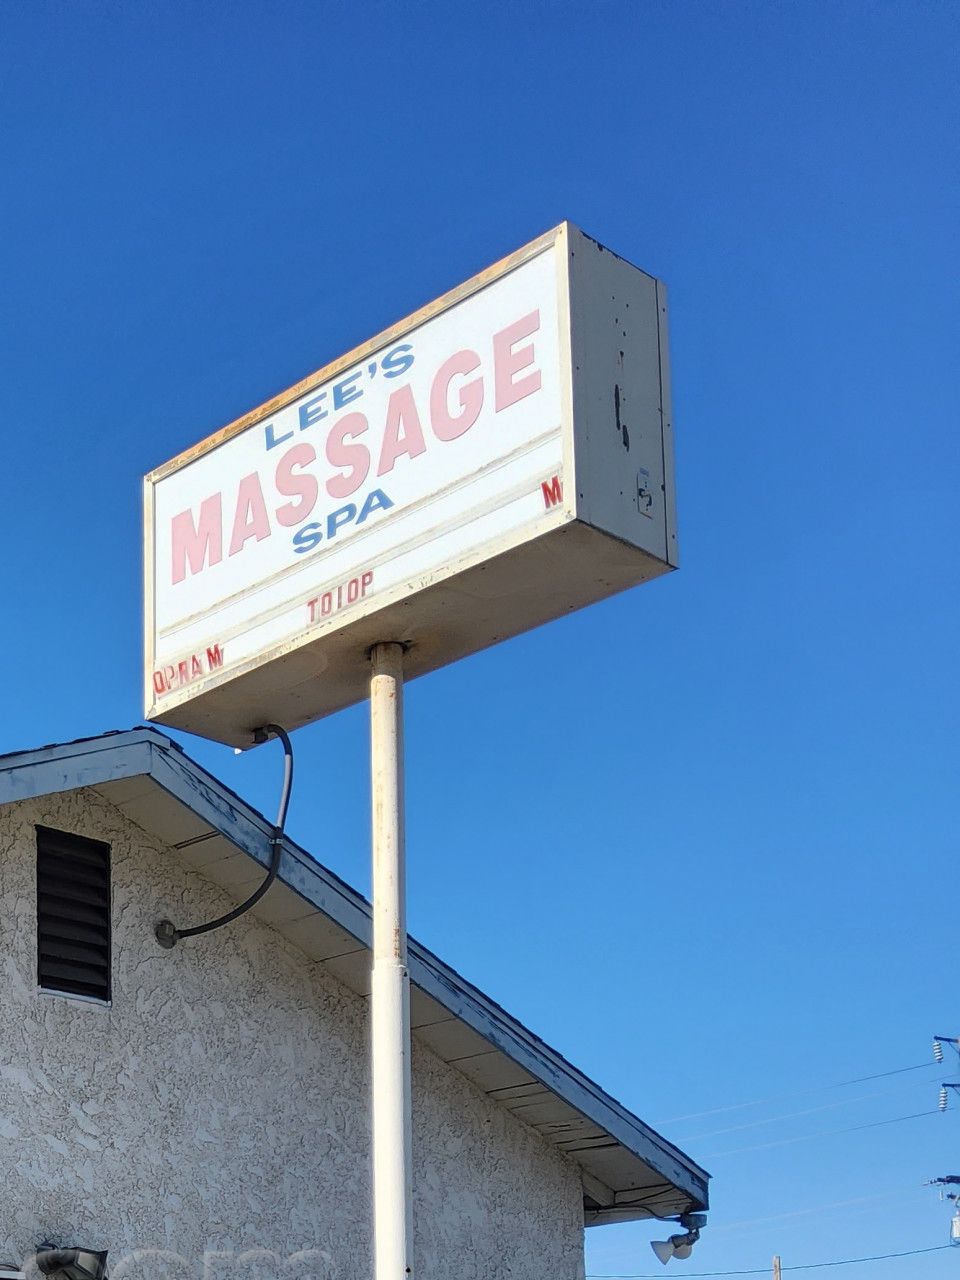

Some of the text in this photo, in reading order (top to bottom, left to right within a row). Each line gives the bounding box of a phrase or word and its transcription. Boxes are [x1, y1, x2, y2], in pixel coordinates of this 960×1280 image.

[265, 344, 415, 451] LEE'S
[170, 308, 543, 586] MASSAGE
[291, 487, 396, 555] SPA
[540, 474, 564, 510] M
